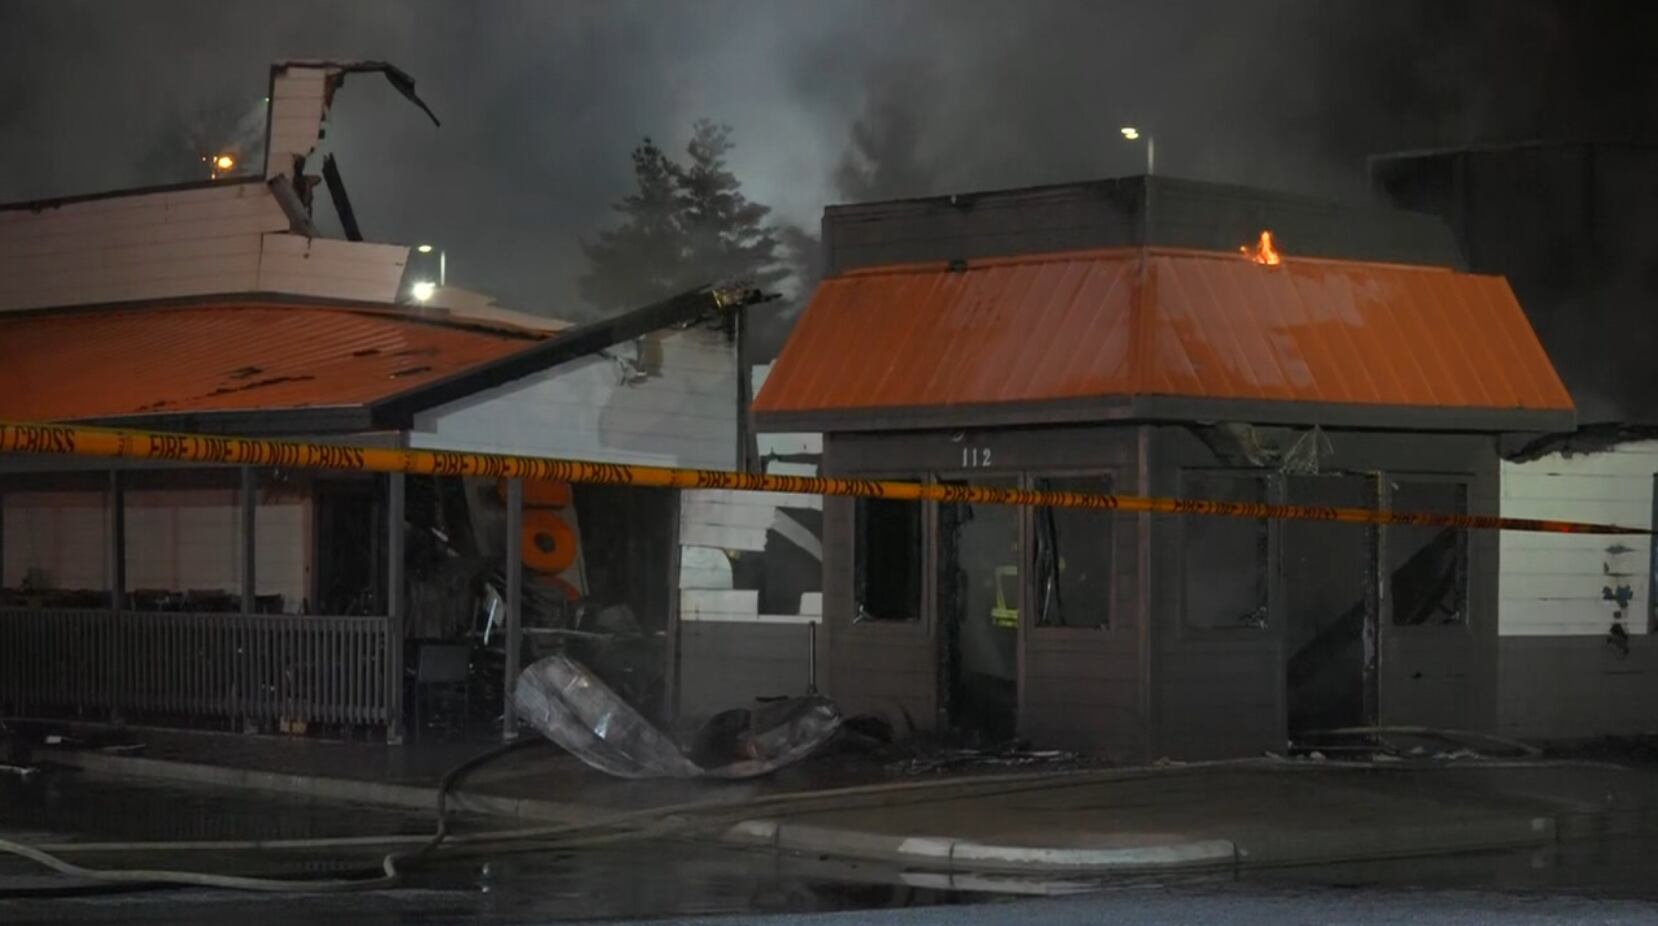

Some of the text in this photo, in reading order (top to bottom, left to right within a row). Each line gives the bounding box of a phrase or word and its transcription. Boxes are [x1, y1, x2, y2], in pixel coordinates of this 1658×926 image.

[13, 425, 75, 453] CROSS
[148, 434, 188, 459] FIRE
[192, 436, 233, 462] LINE
[238, 439, 264, 465] DO
[266, 441, 301, 466] NOT
[307, 443, 365, 469] CROSS
[432, 453, 469, 475] FIRE
[473, 454, 511, 477] LINE
[515, 456, 540, 479] DO
[542, 458, 574, 481] NOT
[578, 461, 633, 485] CROSS
[962, 447, 991, 467] 112
